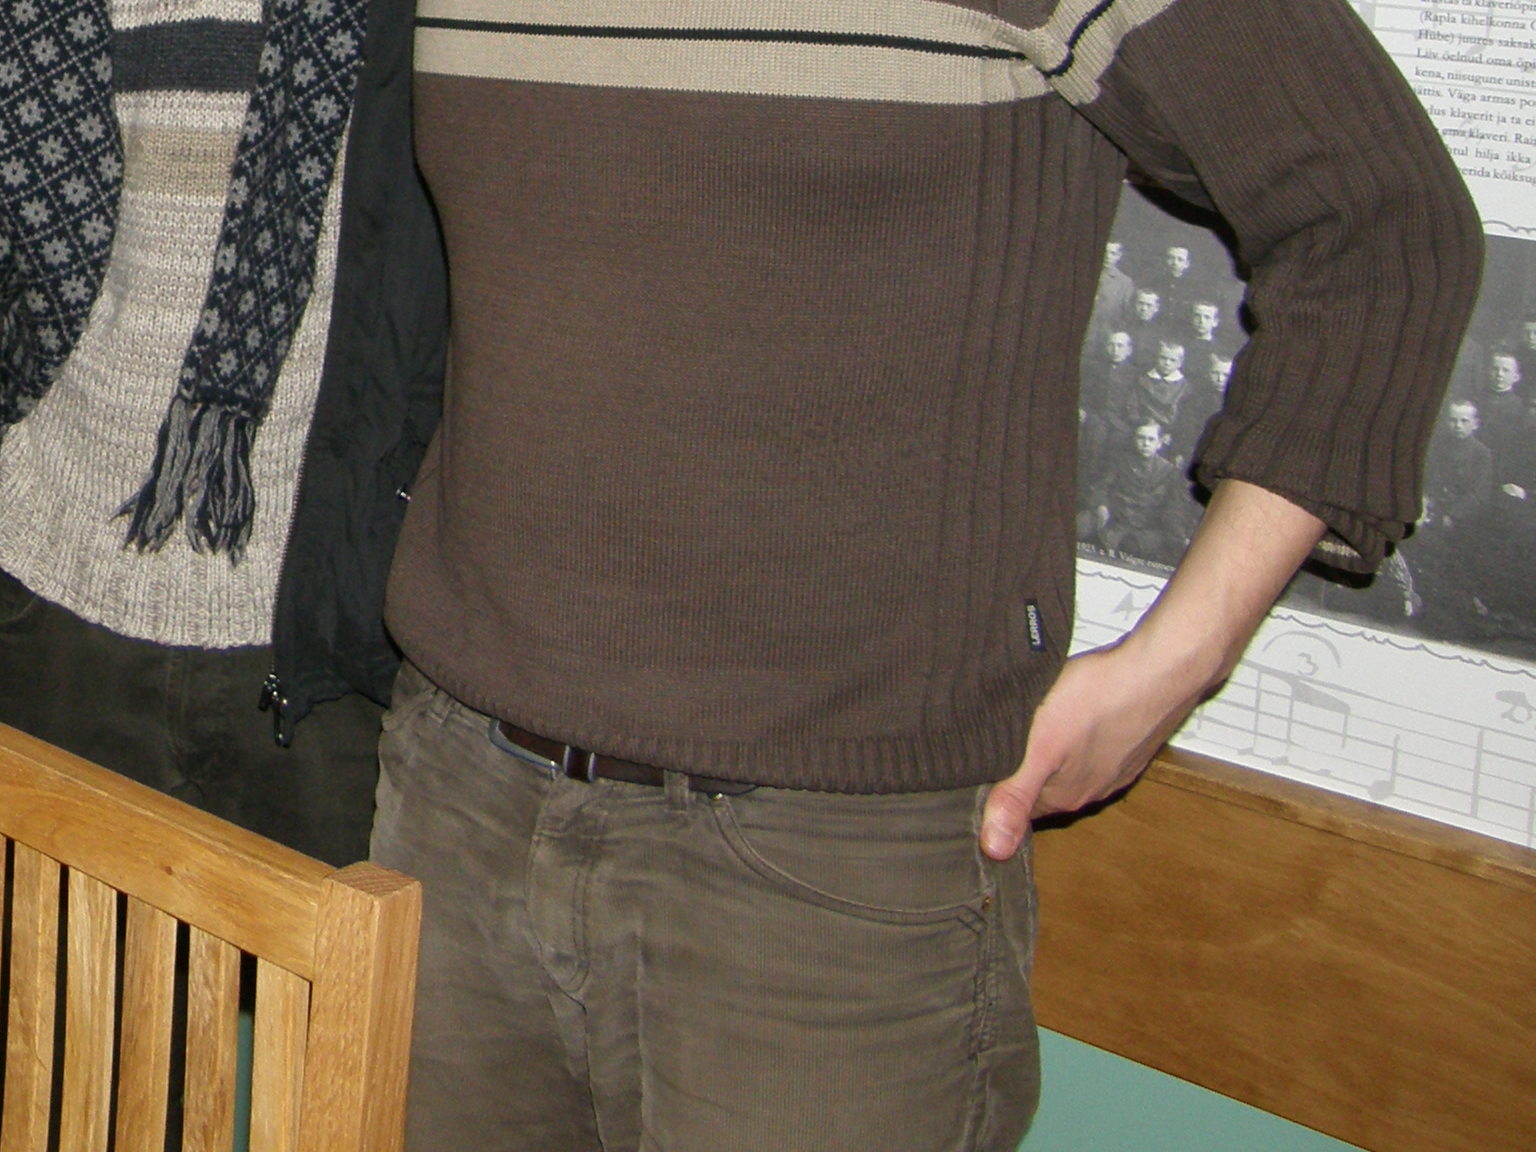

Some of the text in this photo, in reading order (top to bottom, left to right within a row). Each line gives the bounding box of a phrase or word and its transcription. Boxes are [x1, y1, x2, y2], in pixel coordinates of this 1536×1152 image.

[1419, 9, 1456, 27] (Rapla
[1460, 13, 1526, 30] kihelkonna
[1458, 33, 1494, 49] juures
[1416, 47, 1440, 59] Liiv
[1486, 57, 1513, 67] oma
[1415, 65, 1445, 80] kena,
[1447, 70, 1504, 86] niisugune
[1448, 88, 1476, 104] Väga
[1480, 94, 1516, 105] armas
[1450, 108, 1493, 123] klaverit
[1496, 113, 1507, 125] ja
[1510, 115, 1522, 125] ta
[1468, 127, 1511, 143] klaveri.
[1475, 148, 1499, 162] hilja
[1506, 151, 1531, 165] ikka
